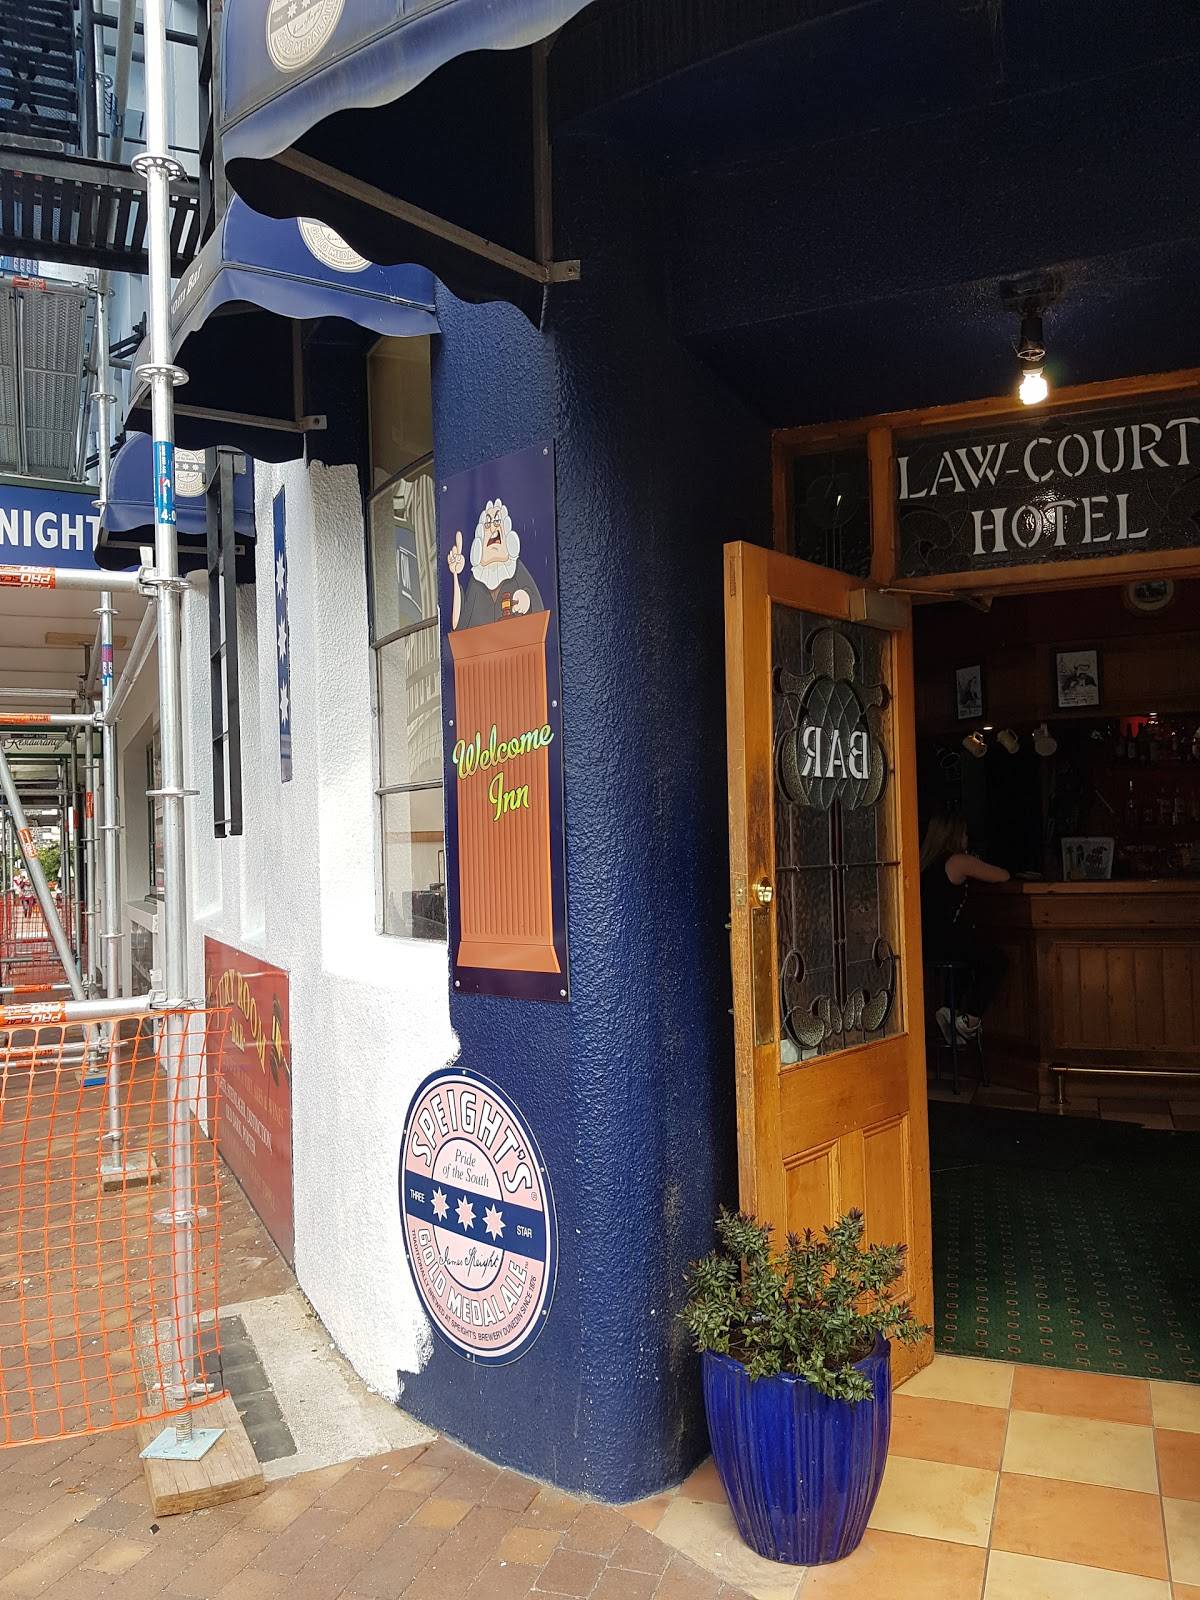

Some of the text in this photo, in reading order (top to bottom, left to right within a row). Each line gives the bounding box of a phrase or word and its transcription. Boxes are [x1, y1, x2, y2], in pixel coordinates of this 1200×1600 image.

[897, 416, 1200, 499] LAW-COURT
[971, 494, 1149, 556] HOTEL
[452, 724, 555, 779] Welcome
[488, 771, 530, 822] Inn
[411, 1089, 533, 1193] SPEIGHT'S
[454, 1149, 477, 1168] Pride
[409, 1188, 425, 1203] THREE
[442, 1163, 489, 1188] of the South
[516, 1225, 533, 1239] STAR
[418, 1228, 528, 1327] GOLD MEDAL ALE
[477, 1332, 503, 1342] BREWERY
[520, 1292, 533, 1316] SINCE
